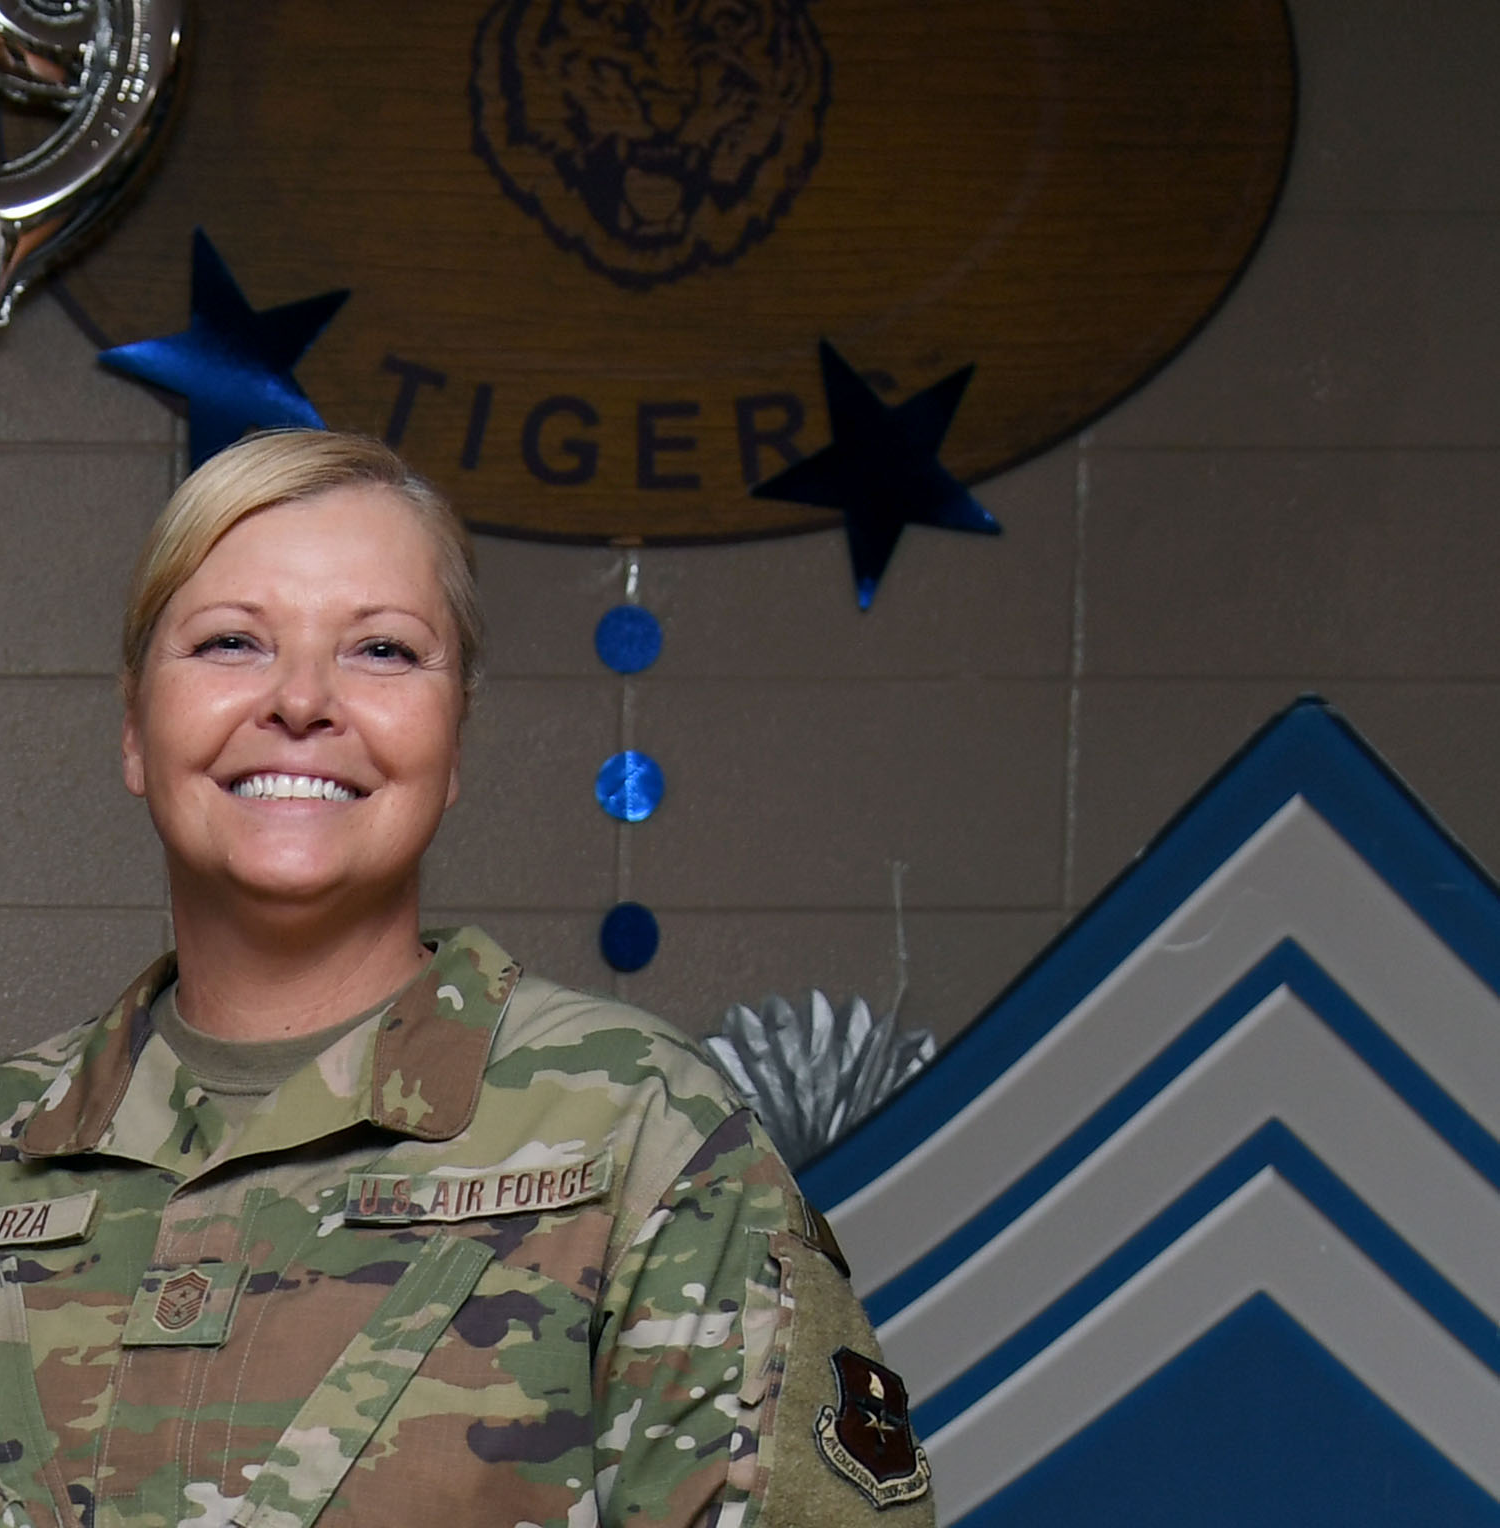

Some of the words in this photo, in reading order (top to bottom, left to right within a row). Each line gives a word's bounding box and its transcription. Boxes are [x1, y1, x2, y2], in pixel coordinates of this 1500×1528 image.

[380, 350, 899, 490] TIGER
[430, 1179, 485, 1214] AIR
[496, 1160, 597, 1208] FORCE
